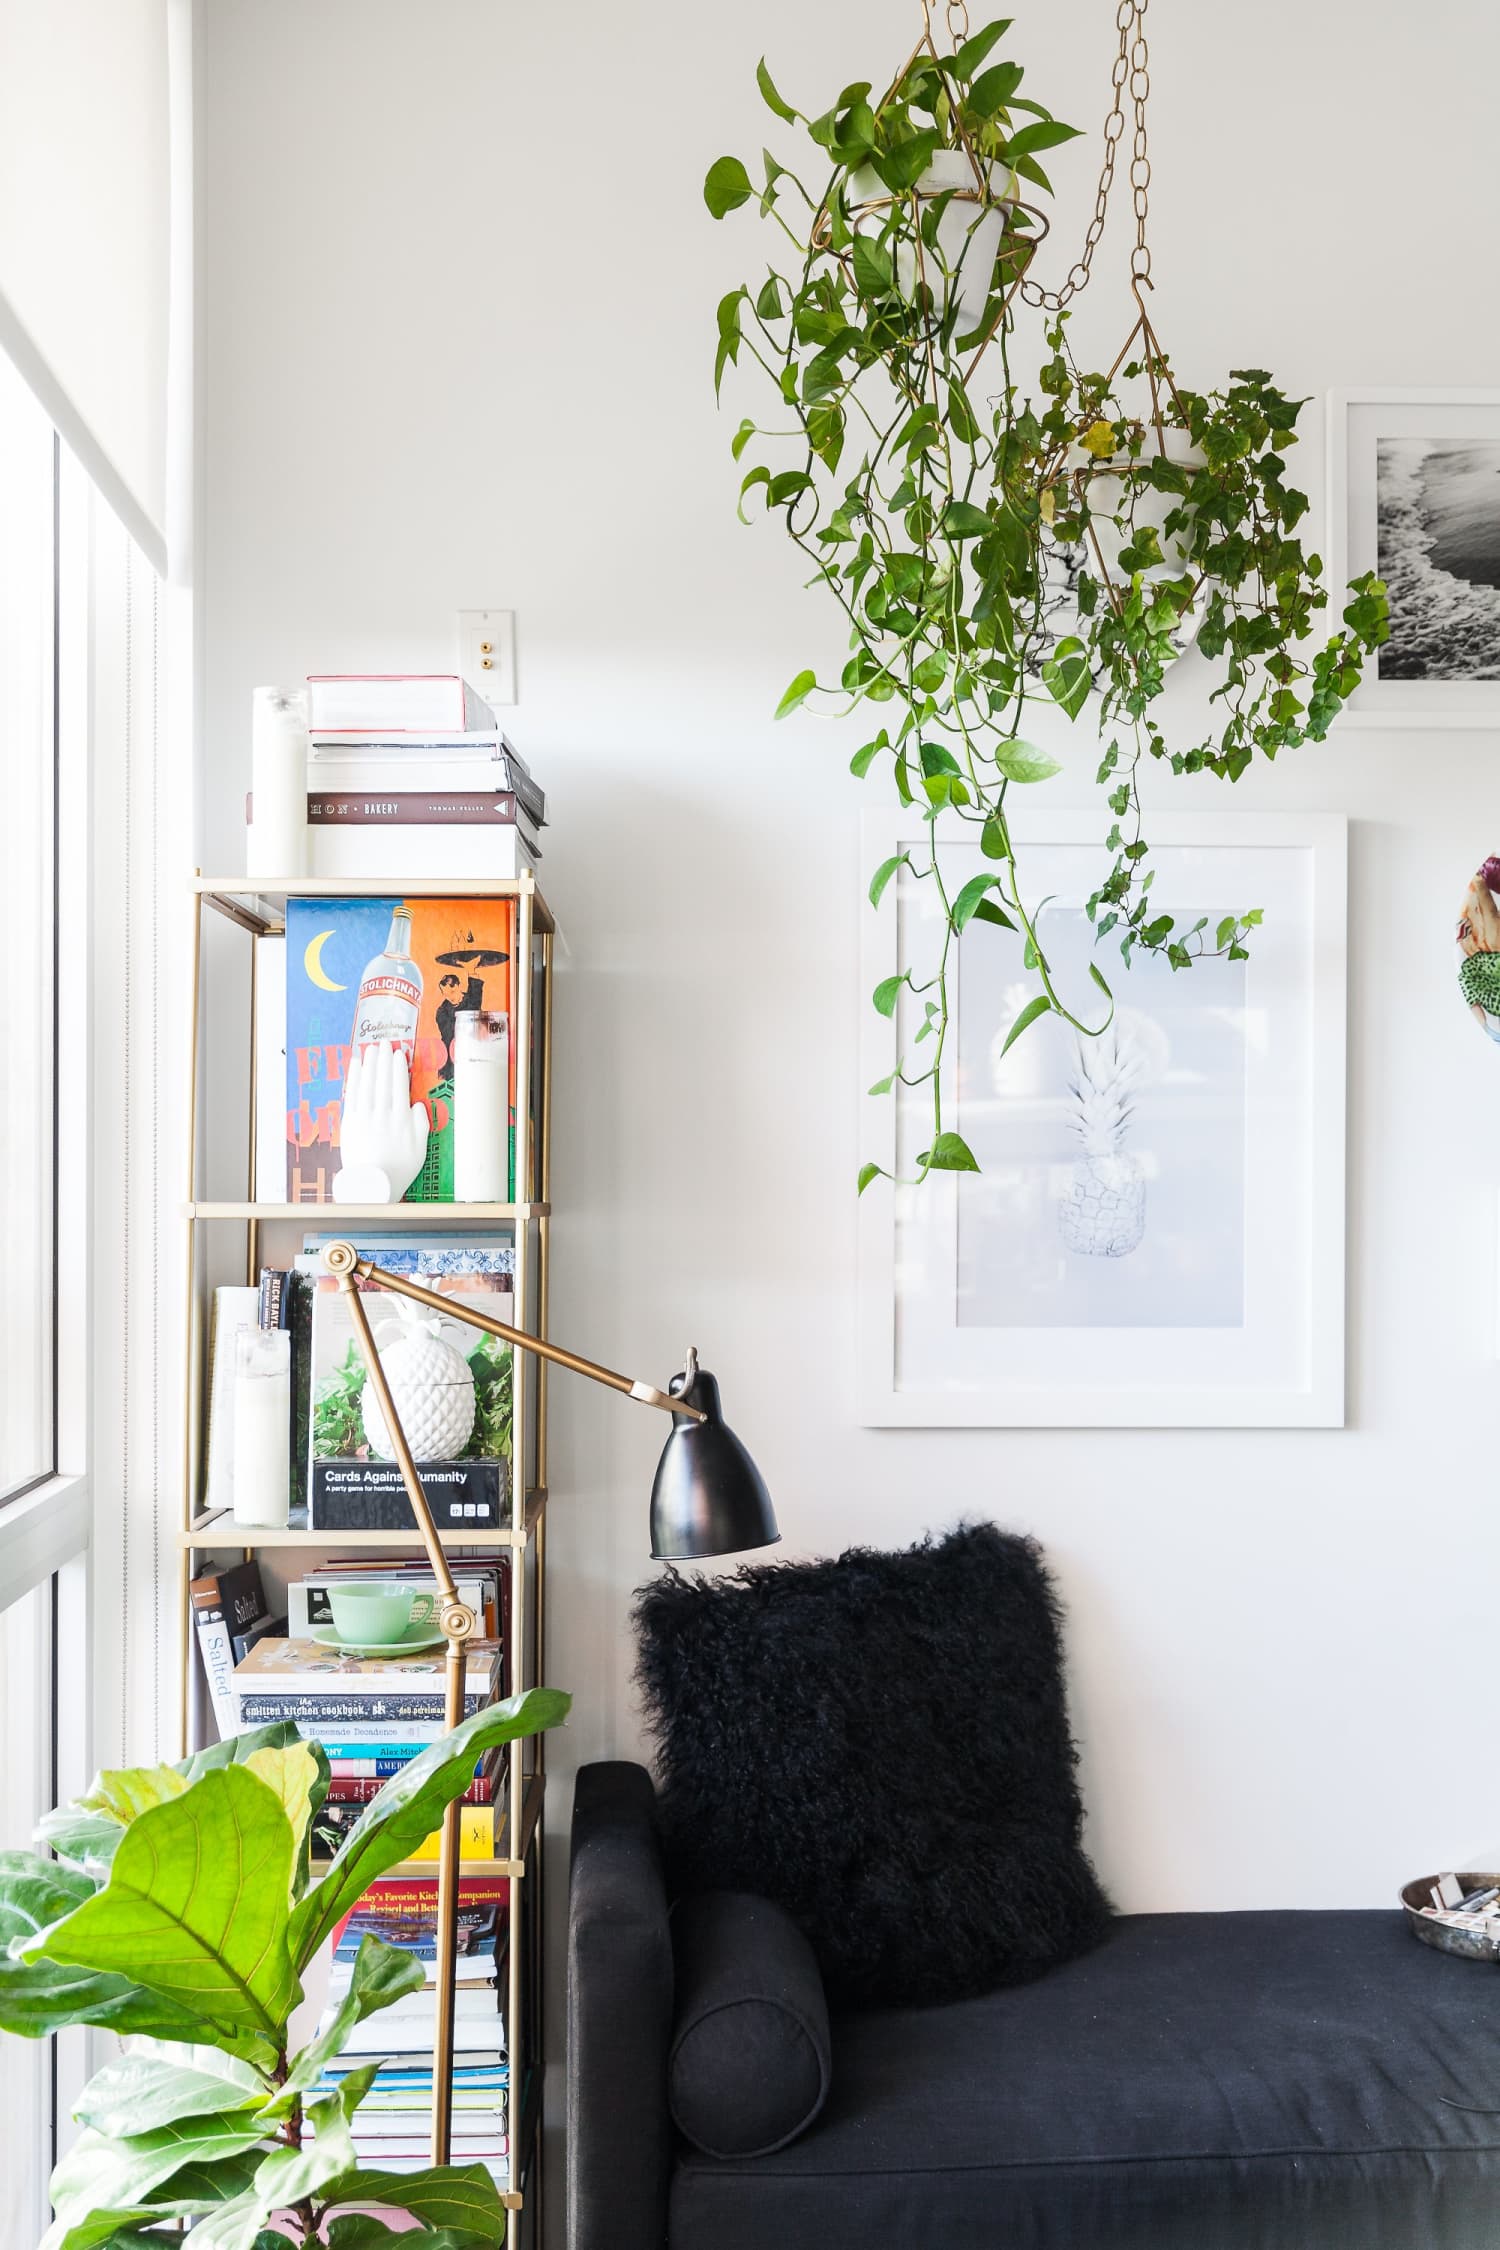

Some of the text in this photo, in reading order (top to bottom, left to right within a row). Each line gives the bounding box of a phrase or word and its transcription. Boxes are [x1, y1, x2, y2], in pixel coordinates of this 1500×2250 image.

[364, 803, 399, 815] BAKERY
[271, 1279, 281, 1302] RICK
[325, 1471, 361, 1482] Cards
[363, 1471, 404, 1484] Agains
[234, 1591, 259, 1624] Salted
[207, 1637, 232, 1696] Salted
[245, 1706, 281, 1716] smitten
[284, 1706, 319, 1717] kitchen
[309, 1728, 351, 1736] Homemade
[354, 1728, 398, 1736] Decadence
[380, 1747, 398, 1756] Alex
[358, 1893, 383, 1904] oday's
[385, 1892, 417, 1901] Favorite
[459, 1889, 501, 1901] ompanion
[370, 1904, 402, 1912] Revised
[403, 1903, 419, 1912] and
